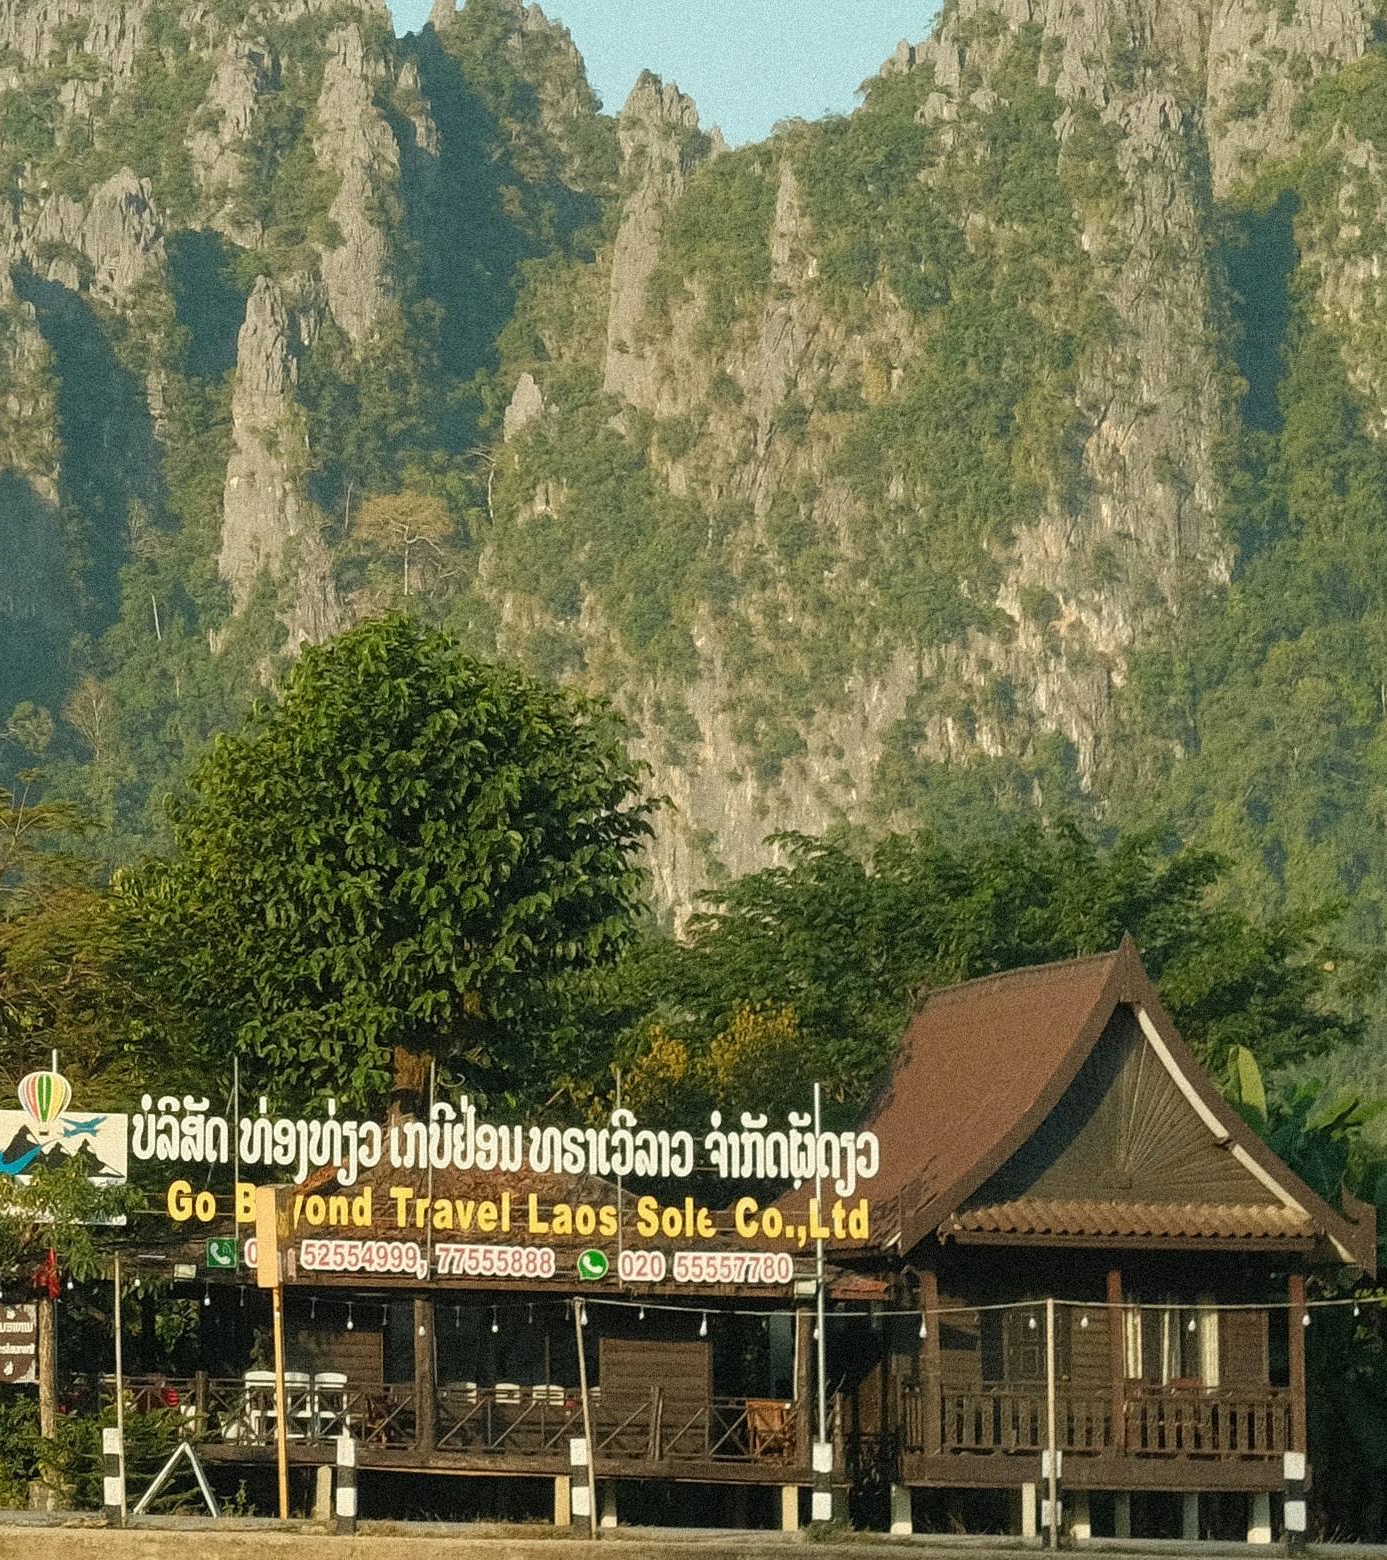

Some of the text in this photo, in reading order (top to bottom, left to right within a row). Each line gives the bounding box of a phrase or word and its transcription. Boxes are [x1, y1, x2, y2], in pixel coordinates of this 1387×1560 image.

[167, 1180, 216, 1222] Go
[390, 1187, 511, 1232] Travel
[528, 1193, 618, 1236] Laos
[435, 1243, 555, 1277] 77555888
[618, 1249, 794, 1283] 020 55557780
